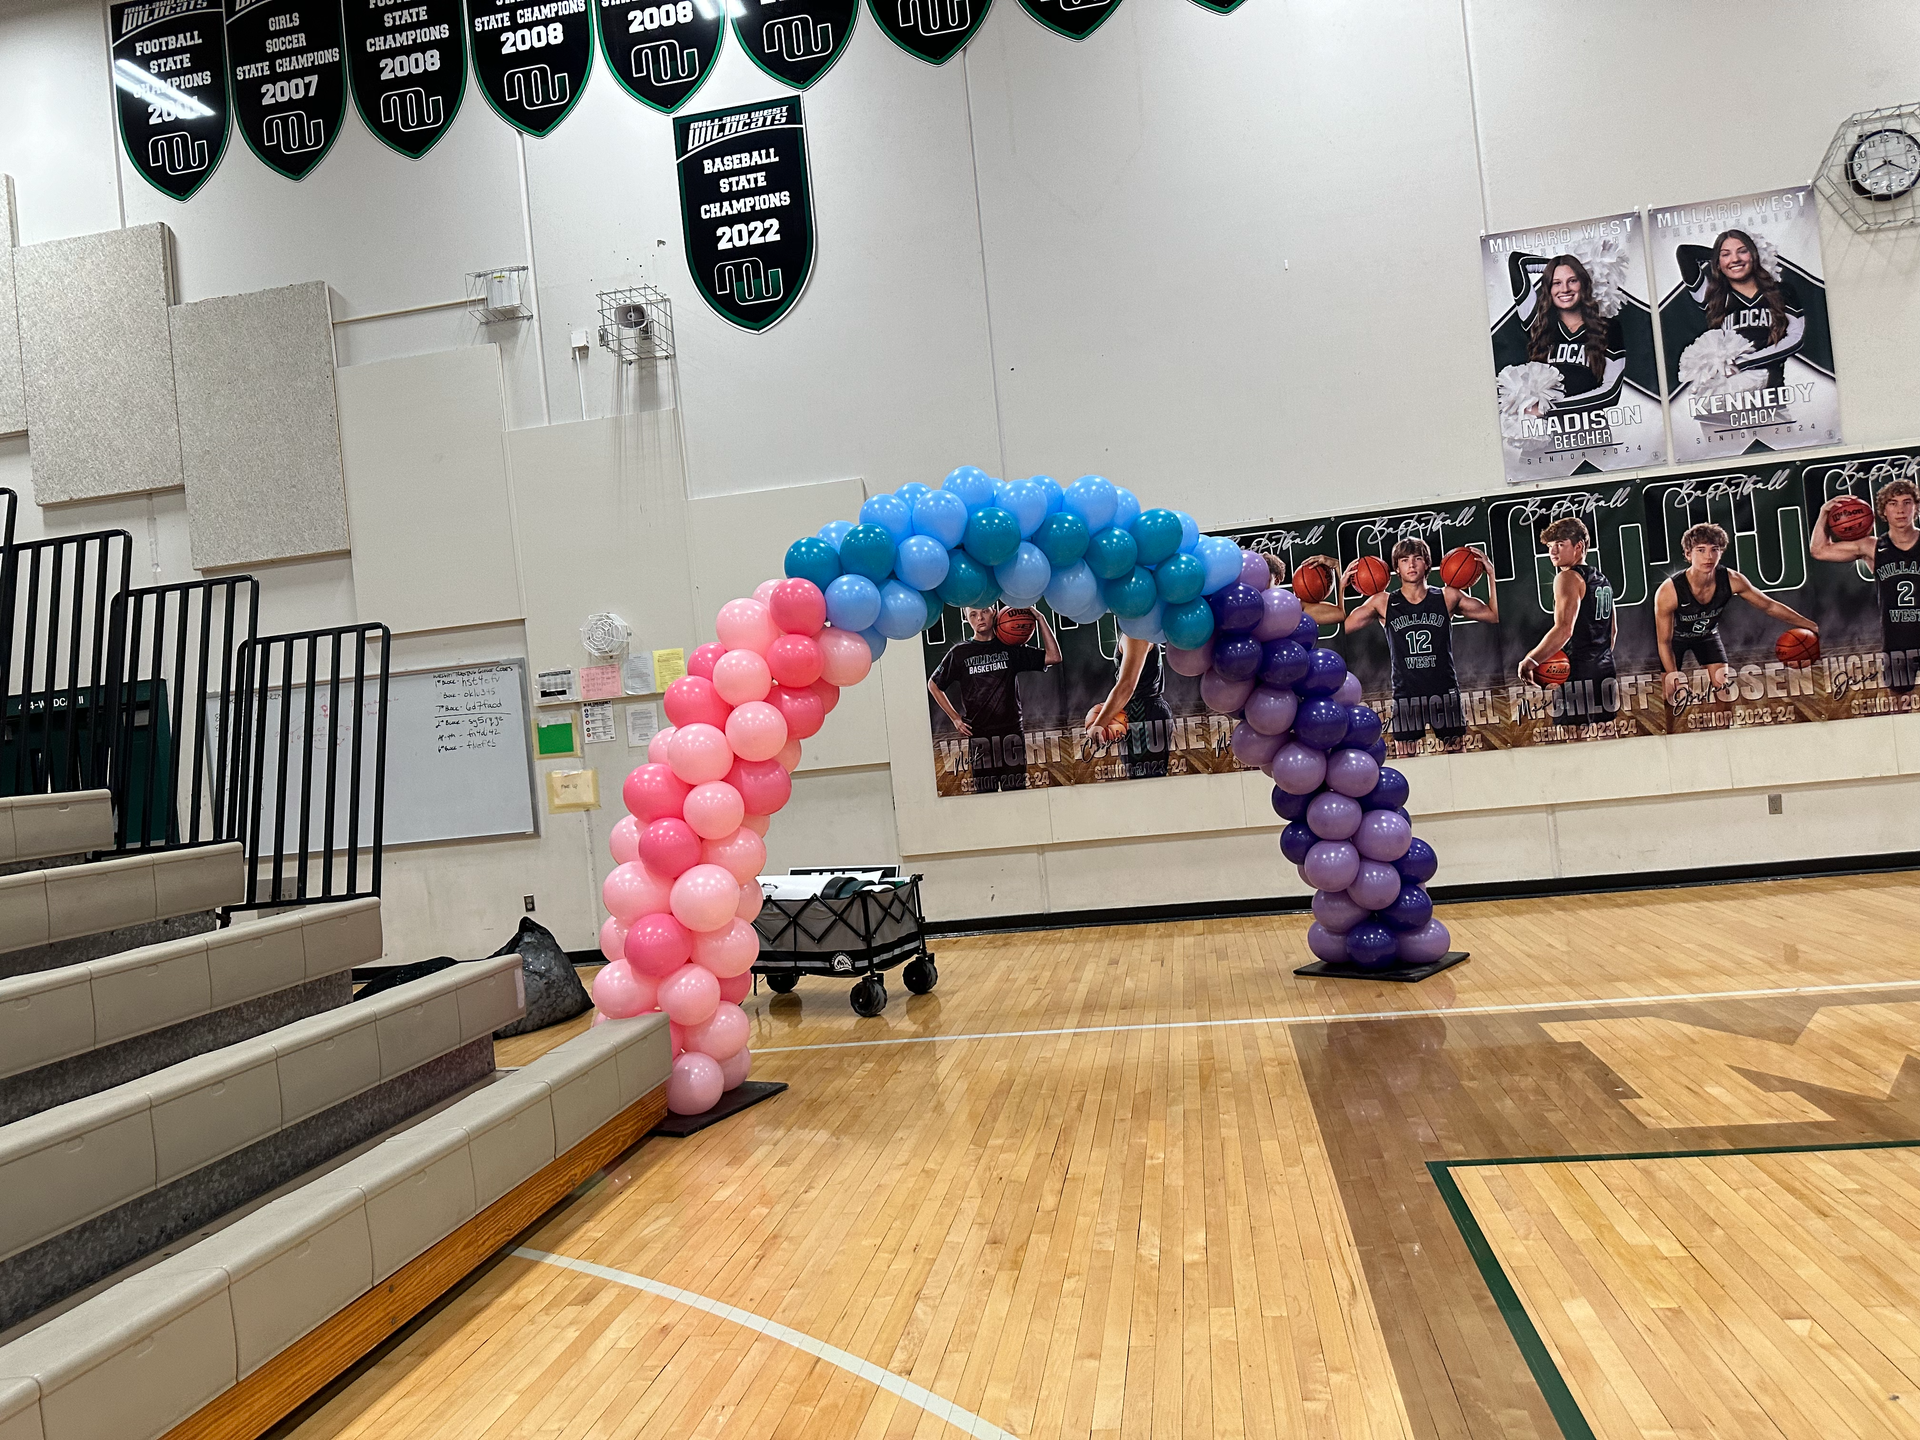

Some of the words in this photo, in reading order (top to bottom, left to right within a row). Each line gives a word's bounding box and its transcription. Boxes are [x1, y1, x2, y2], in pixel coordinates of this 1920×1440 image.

[268, 12, 300, 31] GIRLS
[383, 5, 428, 27] STATE
[474, 11, 511, 32] STATE
[516, 0, 586, 24] CHAMPIONS
[627, 0, 694, 33] 2008
[135, 30, 203, 56] FOOTBALL
[265, 32, 307, 53] SOCCER
[366, 23, 450, 52] CHAMPIONS
[500, 22, 564, 55] 2008
[149, 53, 191, 74] STATE
[236, 61, 270, 80] STATE
[275, 47, 340, 73] CHAMPIONS
[379, 49, 440, 80] 2008
[260, 74, 318, 105] 2007
[147, 95, 203, 125] 20
[690, 112, 749, 130] MILLARD
[750, 105, 789, 119] WEST
[687, 112, 788, 151] WILDCATS
[703, 147, 780, 175] BASEBALL
[719, 171, 767, 193] STATE
[700, 190, 791, 220] CHAMPIONS
[1656, 202, 1743, 229] MILLARD
[1753, 191, 1806, 214] WEST
[715, 217, 781, 250] 2022
[1488, 227, 1571, 254] MILLARD
[1581, 217, 1633, 240] WEST
[1689, 382, 1815, 417] KENNEDY
[1521, 404, 1642, 438] MADISON
[1730, 407, 1777, 428] CAHOY
[1554, 429, 1612, 450] BEECHER
[1696, 430, 1757, 445] SENIOR
[1775, 423, 1816, 435] 2024
[1527, 451, 1586, 465] SENIOR
[1602, 444, 1642, 456] 2024
[1674, 468, 1789, 508] Basketball
[1518, 486, 1631, 526] Basketball
[1367, 505, 1477, 545] Basketball
[1595, 586, 1611, 620] 10
[1897, 580, 1915, 606] 2
[1390, 613, 1445, 632] MILLARD
[1405, 629, 1433, 654] 12
[968, 661, 1008, 675] BASKETBALL
[1404, 655, 1437, 669] WEST
[1822, 649, 1920, 693] INGEBRE
[1508, 674, 1654, 721] FROHLOFF
[1664, 659, 1814, 707] GASSEN
[1687, 710, 1735, 729] SENIOR
[1737, 705, 1796, 725] 2023-24
[1851, 696, 1898, 715] SENIOR
[1071, 716, 1205, 760] FORTUNE
[1386, 739, 1425, 755] ENIOR
[1427, 733, 1482, 753] 2023-24
[1532, 724, 1578, 742] SENIOR
[1580, 718, 1638, 738] 2023-24
[940, 730, 1062, 772] WRIGHT
[960, 774, 998, 792] SENIOR
[1001, 770, 1050, 789] 2023-24
[1094, 762, 1131, 780] SENIOR
